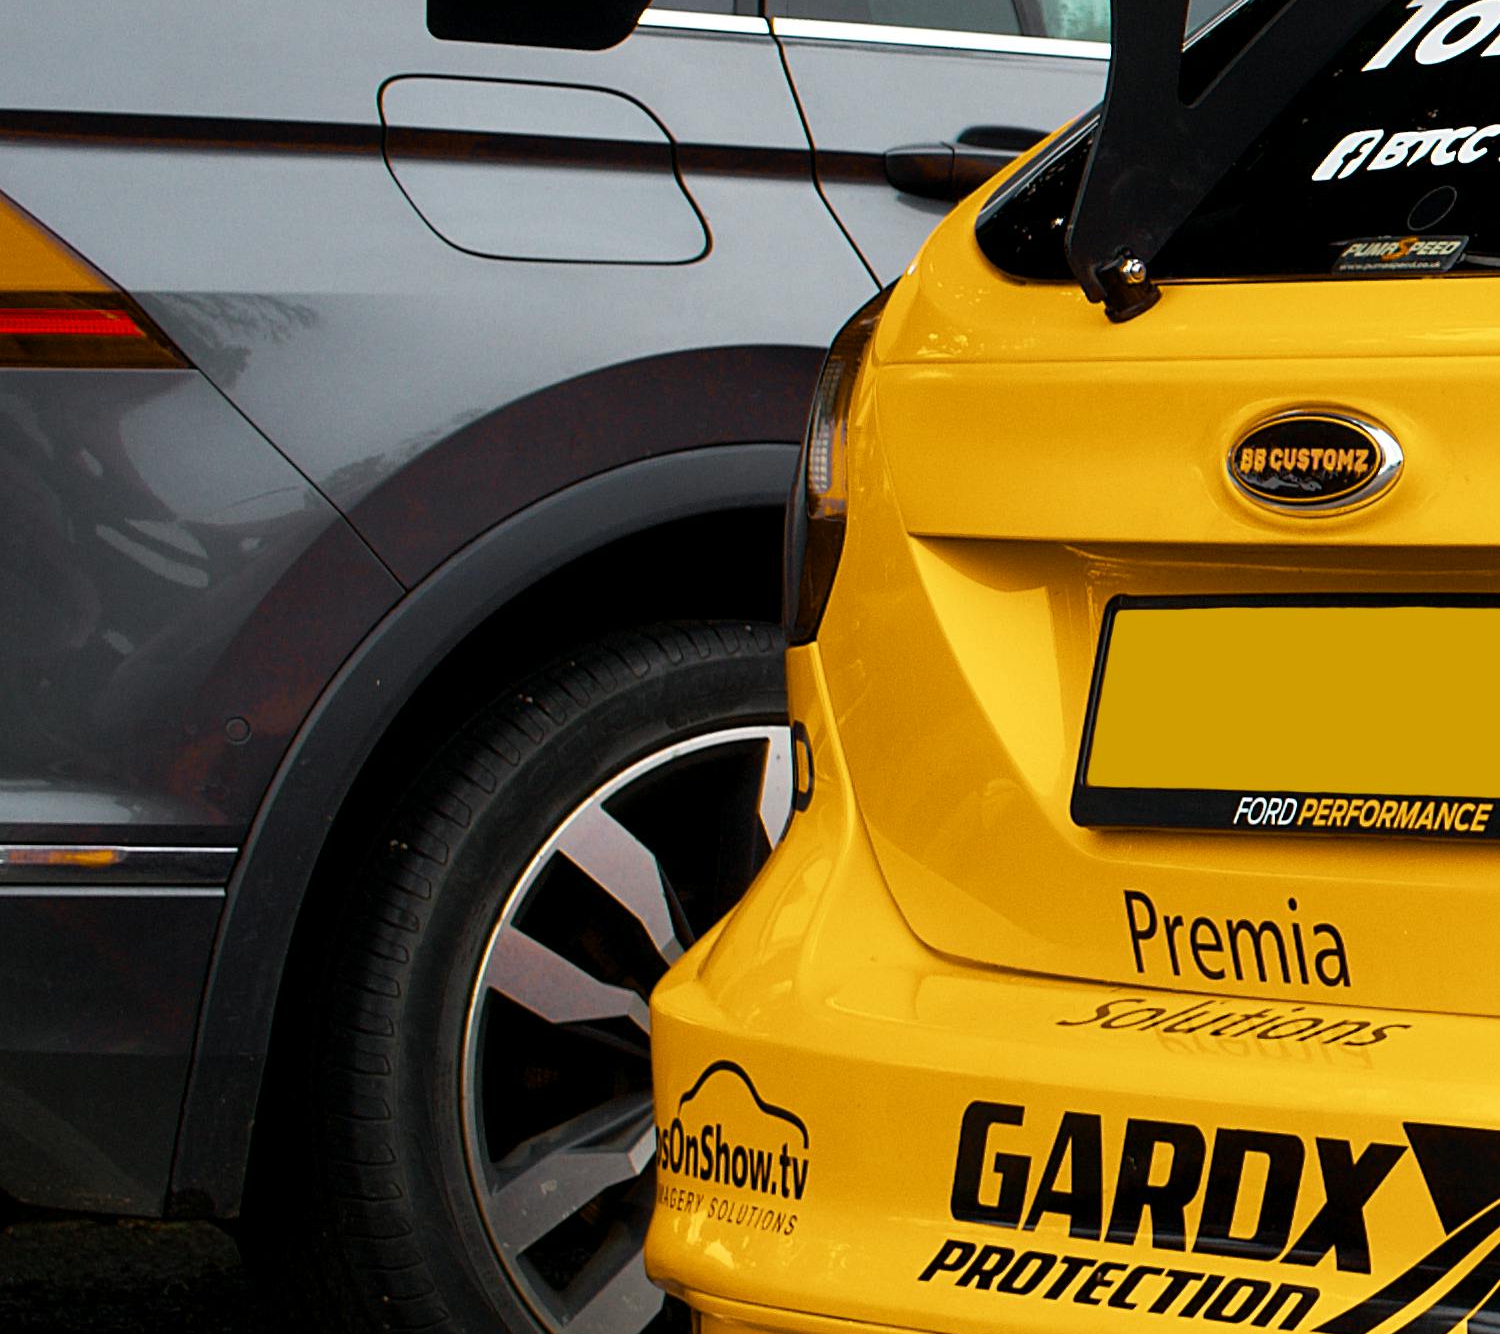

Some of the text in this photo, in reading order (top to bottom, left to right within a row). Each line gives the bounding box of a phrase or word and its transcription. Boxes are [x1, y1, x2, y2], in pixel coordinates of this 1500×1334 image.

[1342, 235, 1462, 262] PUMASPEED
[1269, 447, 1370, 475] CUSTOMZ
[1232, 796, 1494, 834] FORD PERFORMANCE
[1122, 889, 1352, 988] Premia
[1056, 994, 1413, 1050] Solutions
[659, 1184, 798, 1236] AGERY SOLUTIONS
[949, 1099, 1408, 1275] GARDX
[917, 1239, 1321, 1333] PROTECTION
